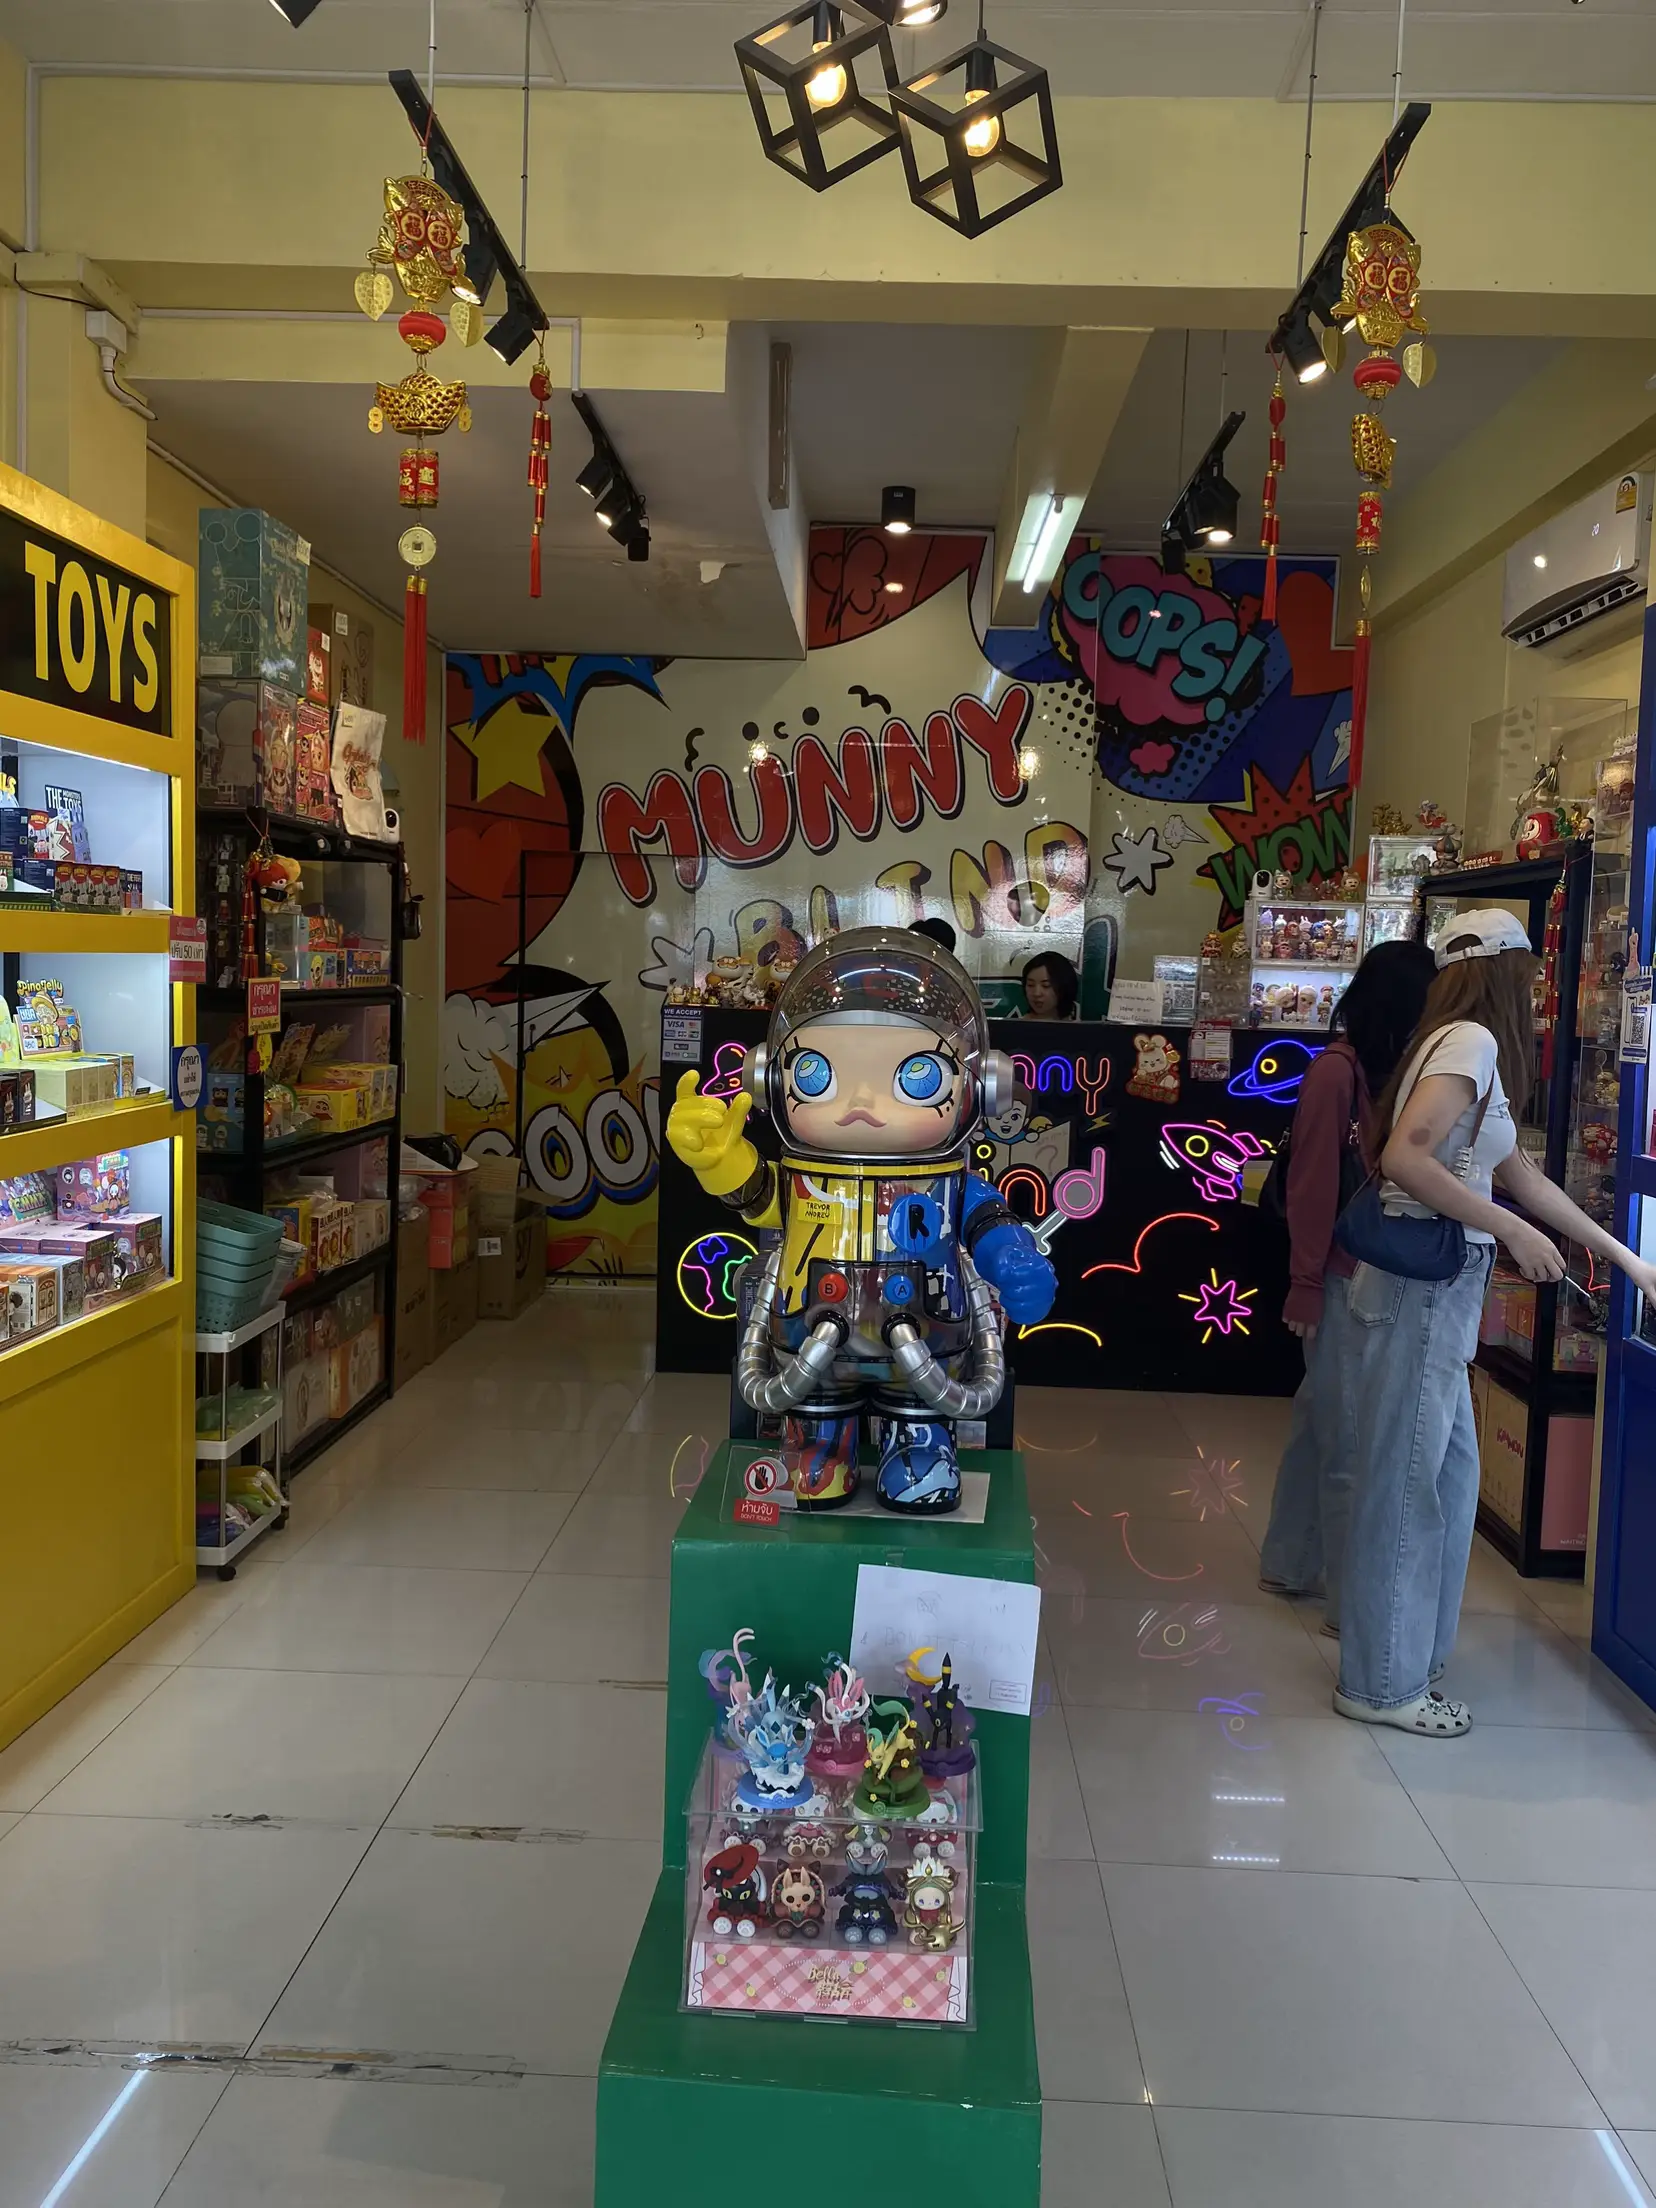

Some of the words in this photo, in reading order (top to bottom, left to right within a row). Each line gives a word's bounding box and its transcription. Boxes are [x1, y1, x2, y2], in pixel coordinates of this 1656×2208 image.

[25, 540, 159, 713] TOYS
[1062, 552, 1269, 723] OOPS!
[45, 787, 63, 809] THE
[597, 684, 1034, 906] MUNNY
[184, 945, 192, 959] 50
[253, 983, 276, 1000] กรุณา
[180, 1055, 199, 1070] กรุณา
[806, 1201, 830, 1211] TREVOR
[804, 1210, 830, 1219] ANDREW
[908, 1203, 930, 1240] R
[824, 1284, 832, 1294] B
[897, 1284, 908, 1296] A
[741, 1501, 774, 1516] ห้ามจับ
